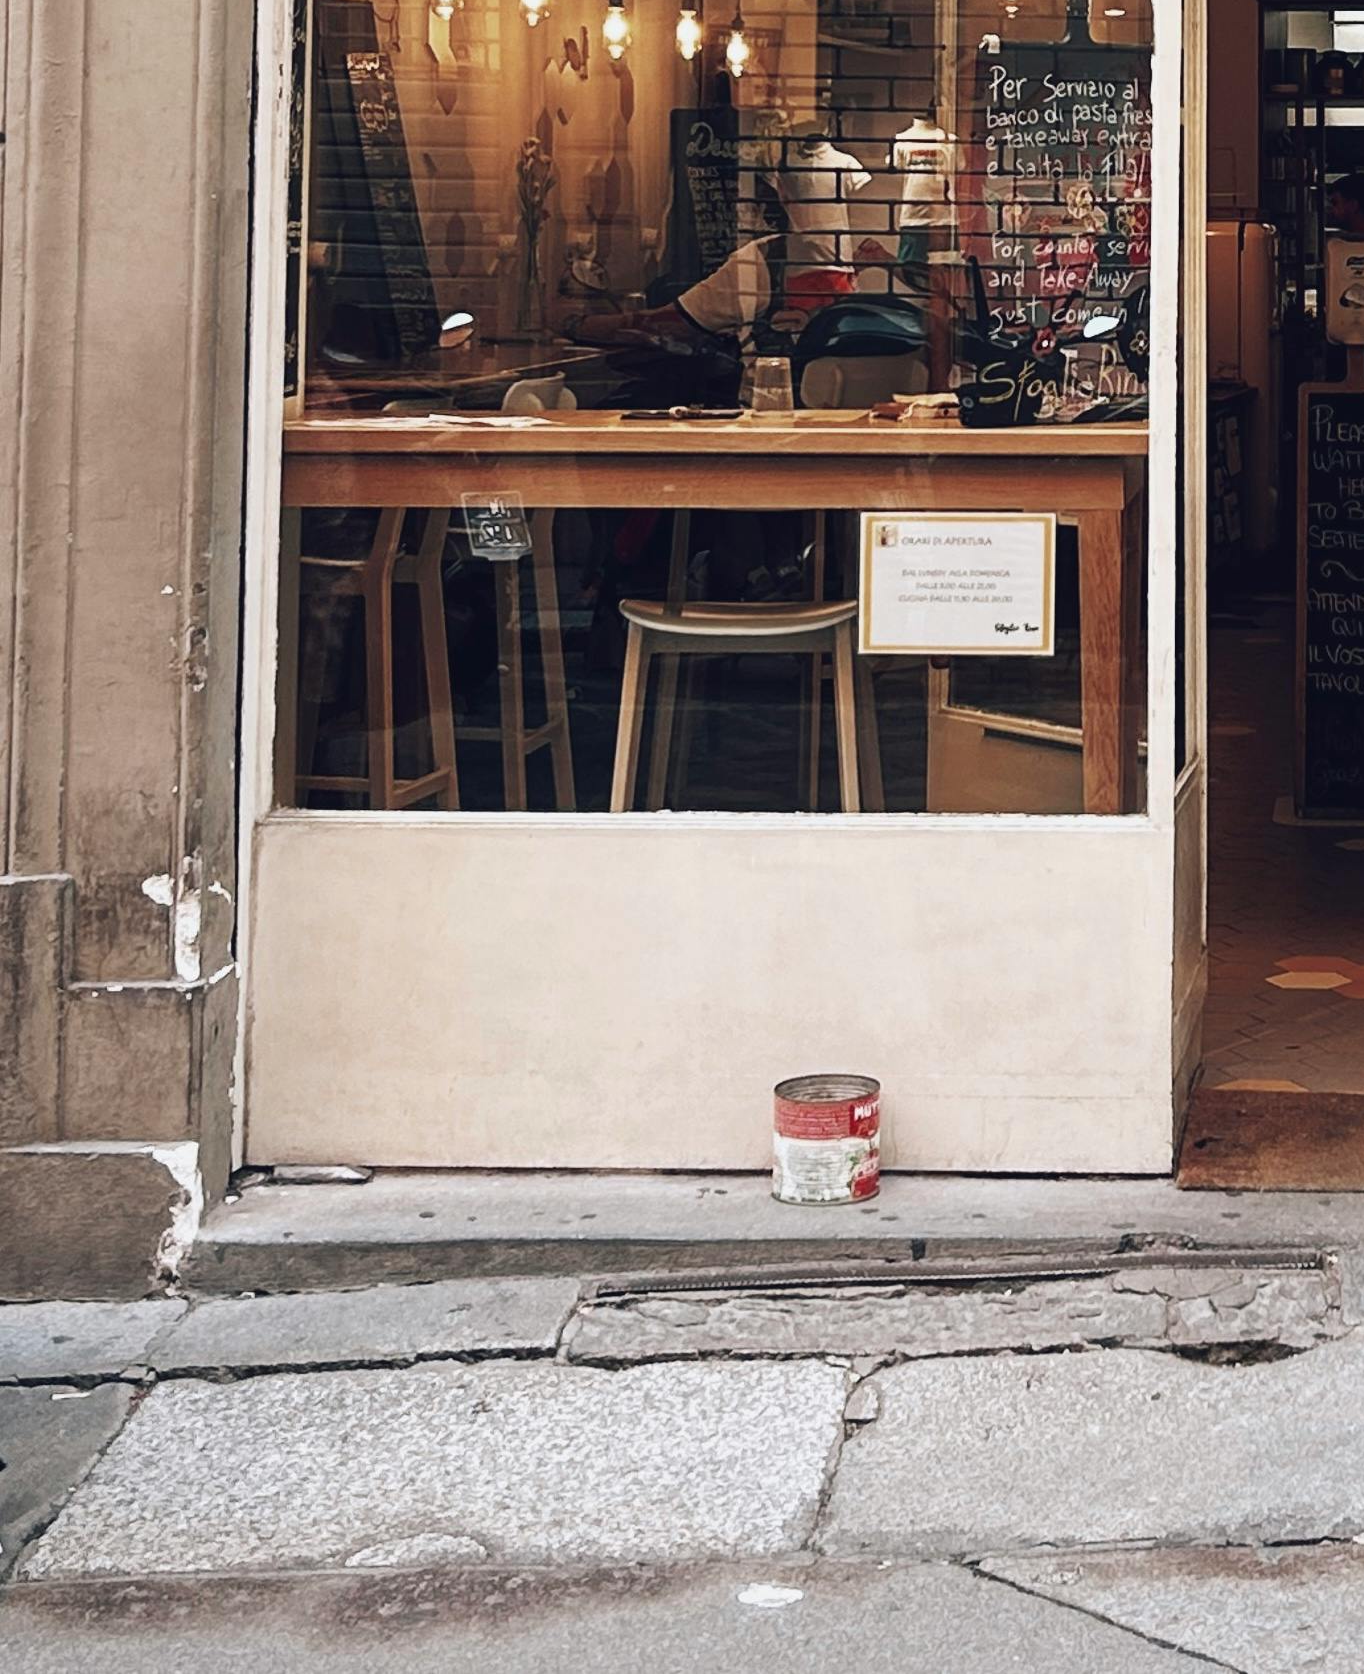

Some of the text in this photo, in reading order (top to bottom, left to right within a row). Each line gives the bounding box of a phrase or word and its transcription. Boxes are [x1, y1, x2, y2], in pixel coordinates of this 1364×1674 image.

[988, 65, 1138, 102] Per Servizio al
[986, 100, 1152, 131] banco di pasta fres
[986, 136, 996, 151] e
[1002, 129, 1090, 151] takeaway
[986, 160, 999, 178] e
[1015, 153, 1064, 179] salta
[1077, 152, 1094, 181] la
[991, 230, 1025, 259] For
[1032, 232, 1099, 256] counter
[988, 259, 1025, 288] and
[1308, 503, 1337, 520] TO
[1331, 616, 1364, 637] QUI
[1308, 645, 1323, 663] IL
